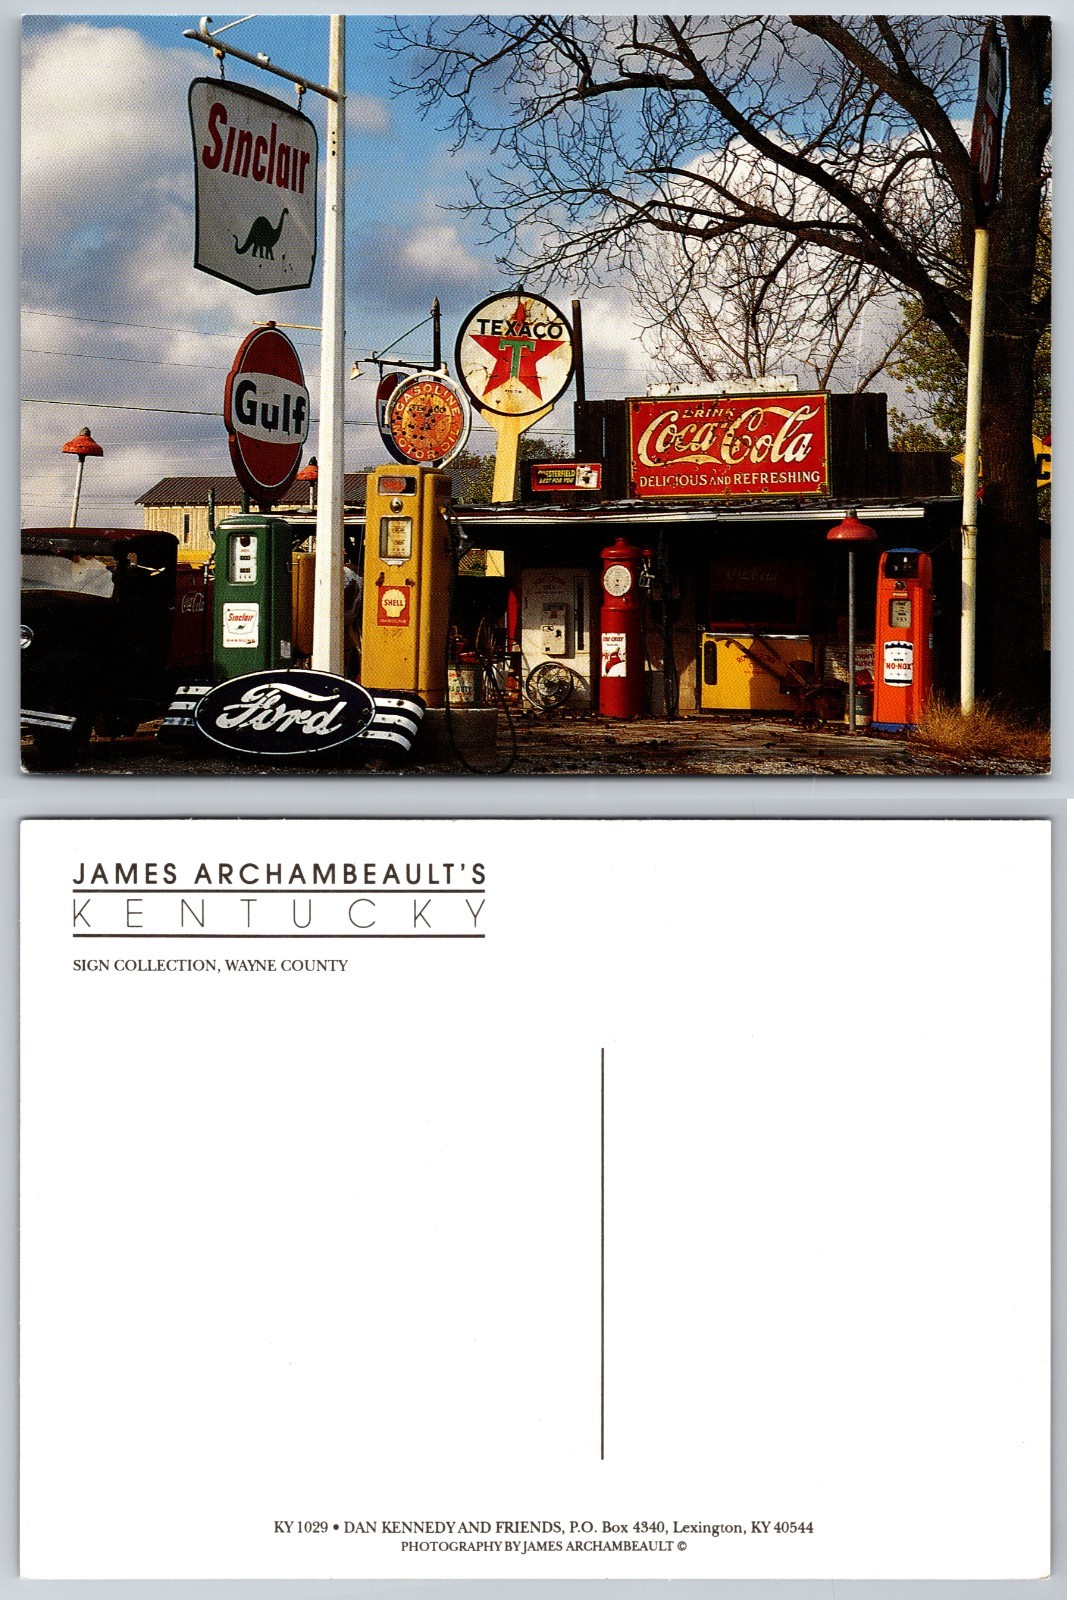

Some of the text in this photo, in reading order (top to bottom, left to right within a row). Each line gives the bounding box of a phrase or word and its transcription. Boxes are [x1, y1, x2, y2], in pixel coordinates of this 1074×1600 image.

[202, 102, 310, 194] Sinclair
[476, 318, 563, 339] TEXACO
[234, 379, 306, 436] Gulf
[396, 383, 461, 416] GASOLINE
[411, 404, 447, 414] TECO
[681, 407, 735, 418] DRINK
[637, 405, 821, 468] Coca-Cola
[537, 469, 575, 478] ESTERFIELD
[640, 471, 821, 487] DELICIOUS AND REFRESHING
[228, 612, 254, 621] Sinclair
[885, 662, 912, 670] NO-NOX
[215, 683, 348, 735] Ford
[73, 863, 486, 884] JAMES ARCHAMBEAULT'S
[73, 898, 486, 928] KENTUCKY
[73, 959, 349, 974] SIGN COLLECTION, WAYNE COUNTY
[274, 1520, 814, 1537] KY 1029 DAN KENNEDY AND FRIENDS, P.O. Box 4340, Lexington, KY 40544
[401, 1541, 503, 1552] PHOTOGRAPHY
[505, 1541, 521, 1552] BY
[521, 1541, 562, 1554] JAMES
[565, 1540, 675, 1551] ARCHAMBEAULT
